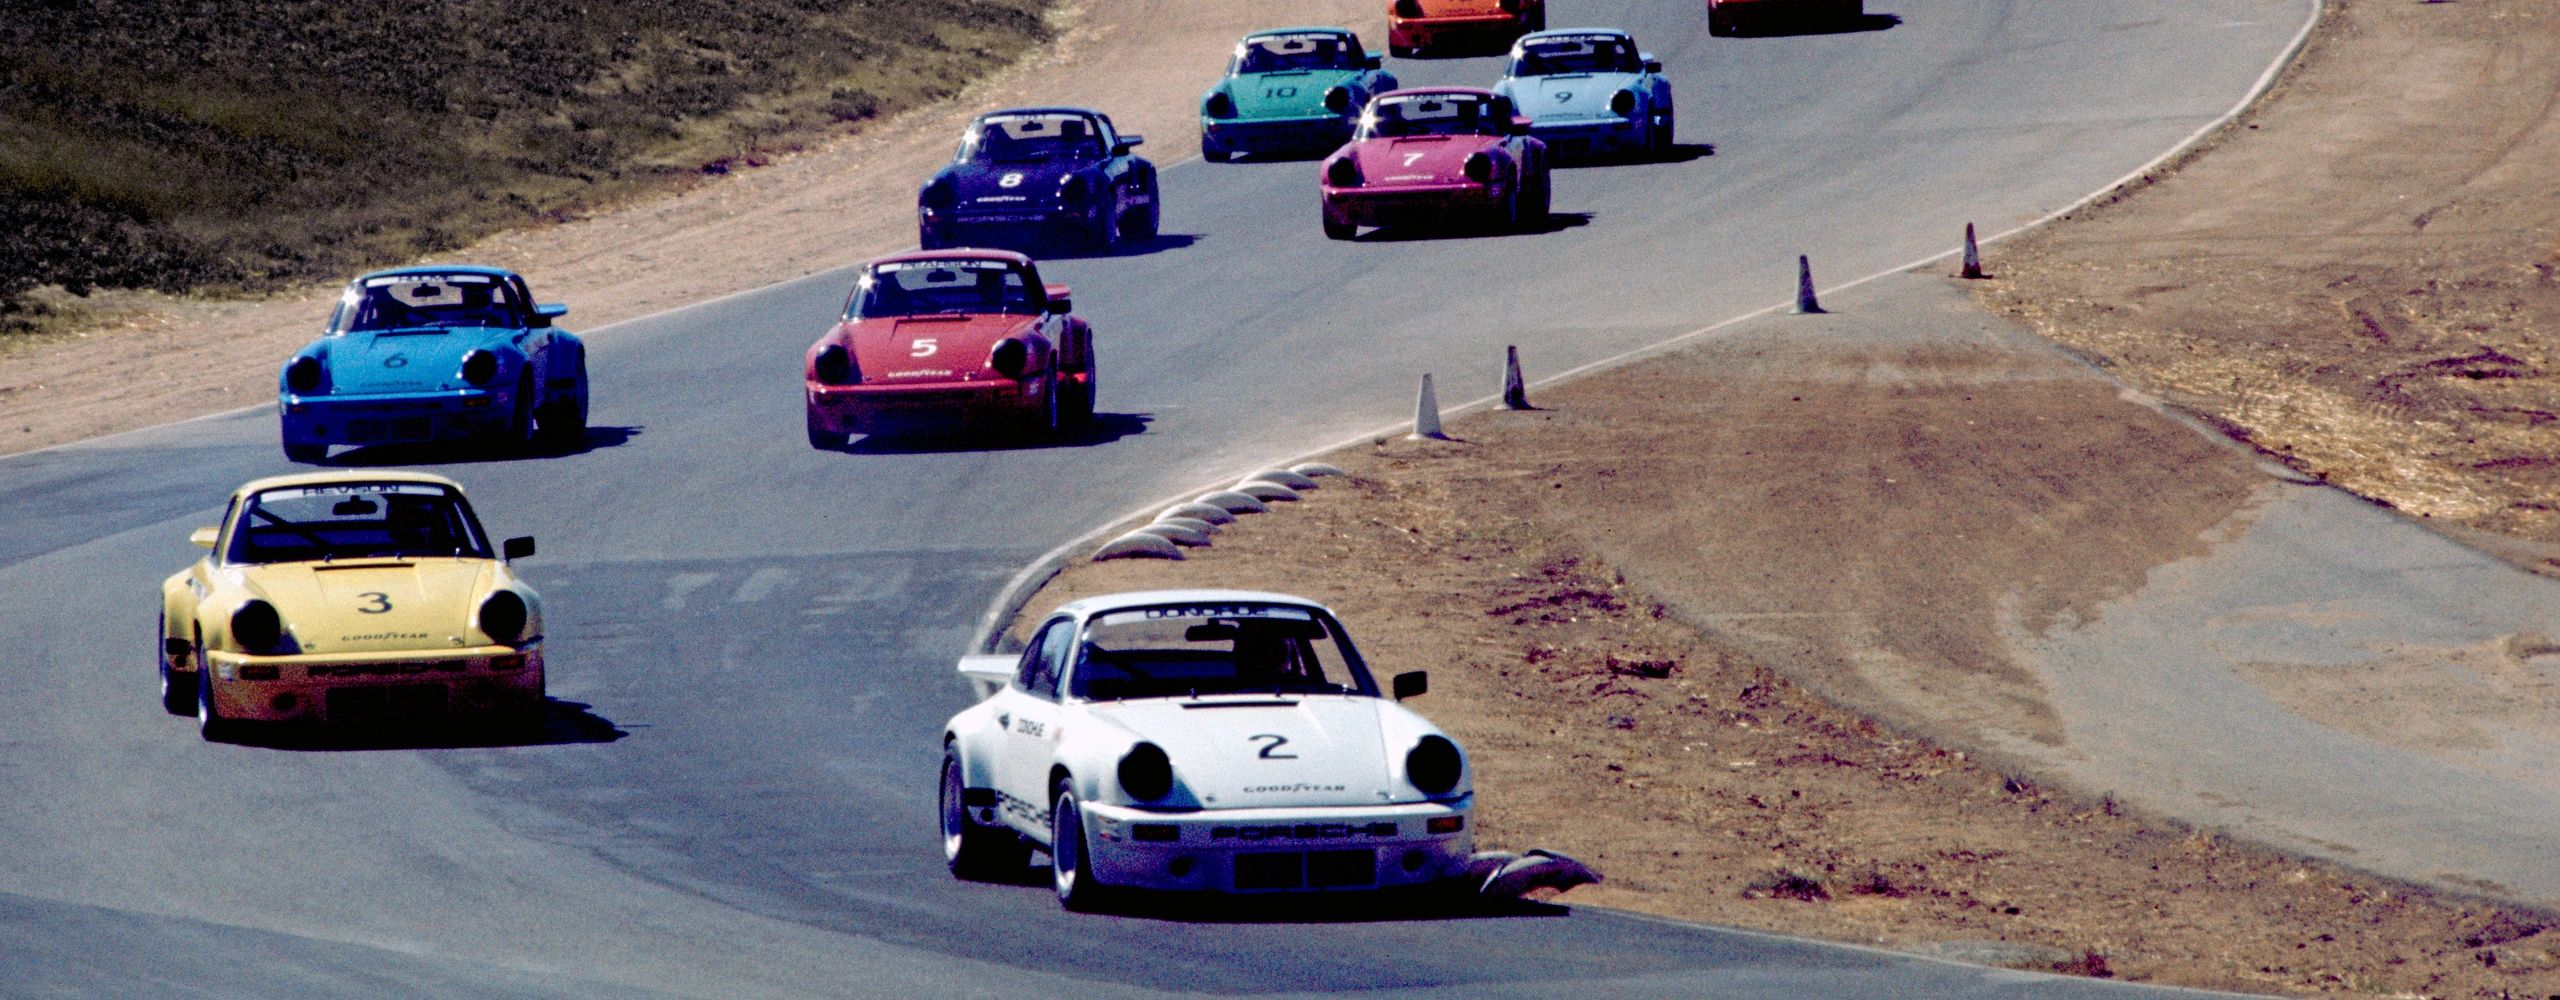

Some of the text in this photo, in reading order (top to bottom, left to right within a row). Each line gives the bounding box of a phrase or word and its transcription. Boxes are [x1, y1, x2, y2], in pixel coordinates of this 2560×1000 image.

[1266, 88, 1298, 99] 10
[1555, 92, 1573, 104] 9
[1403, 153, 1424, 167] 7
[999, 173, 1023, 188] 8
[911, 339, 938, 358] 5
[384, 354, 408, 368] 6
[357, 592, 393, 614] 3
[341, 632, 429, 641] GOODYEAR
[1248, 733, 1299, 760] 2
[1243, 783, 1346, 794] GOODYEAR
[1210, 823, 1398, 843] PORSCHE
